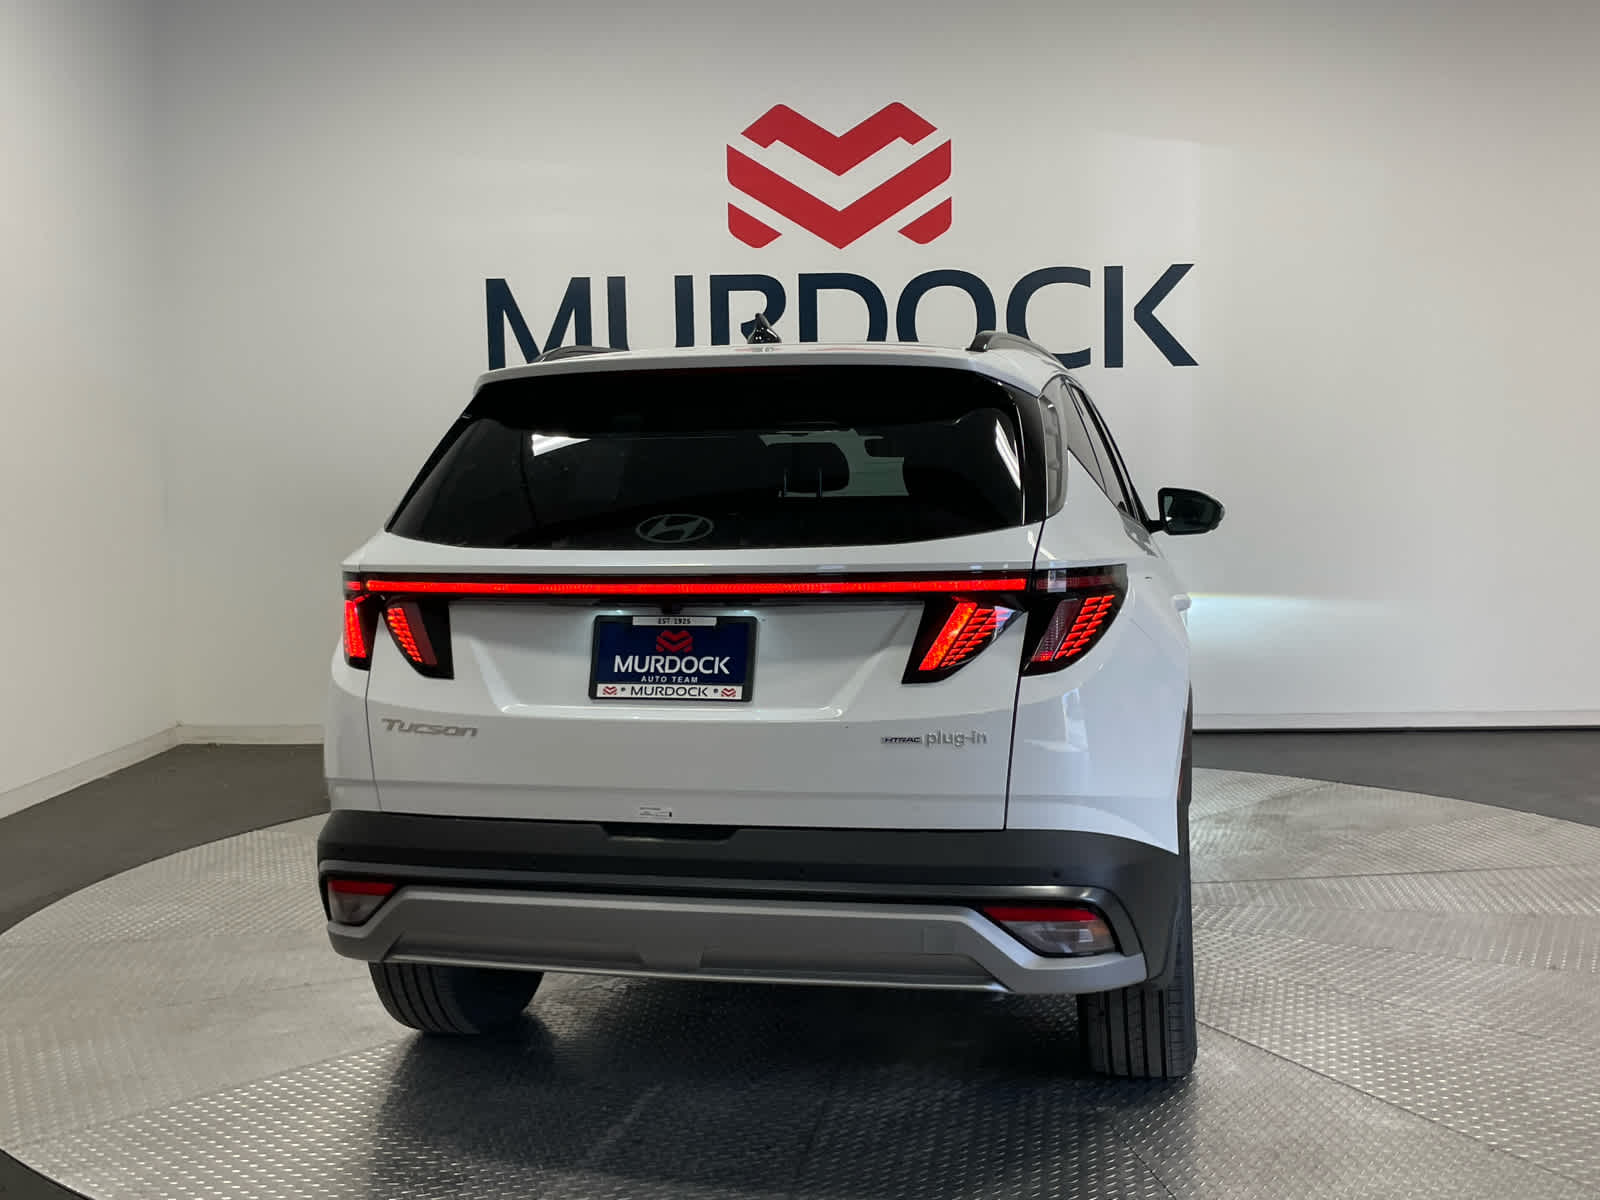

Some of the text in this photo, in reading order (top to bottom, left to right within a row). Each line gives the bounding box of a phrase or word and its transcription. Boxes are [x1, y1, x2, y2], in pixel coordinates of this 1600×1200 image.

[485, 263, 1199, 369] MURDOCK
[613, 655, 731, 675] MURDOCK
[641, 675, 667, 683] AUTO
[630, 686, 708, 697] MURDOCK
[926, 729, 987, 748] plug-in
